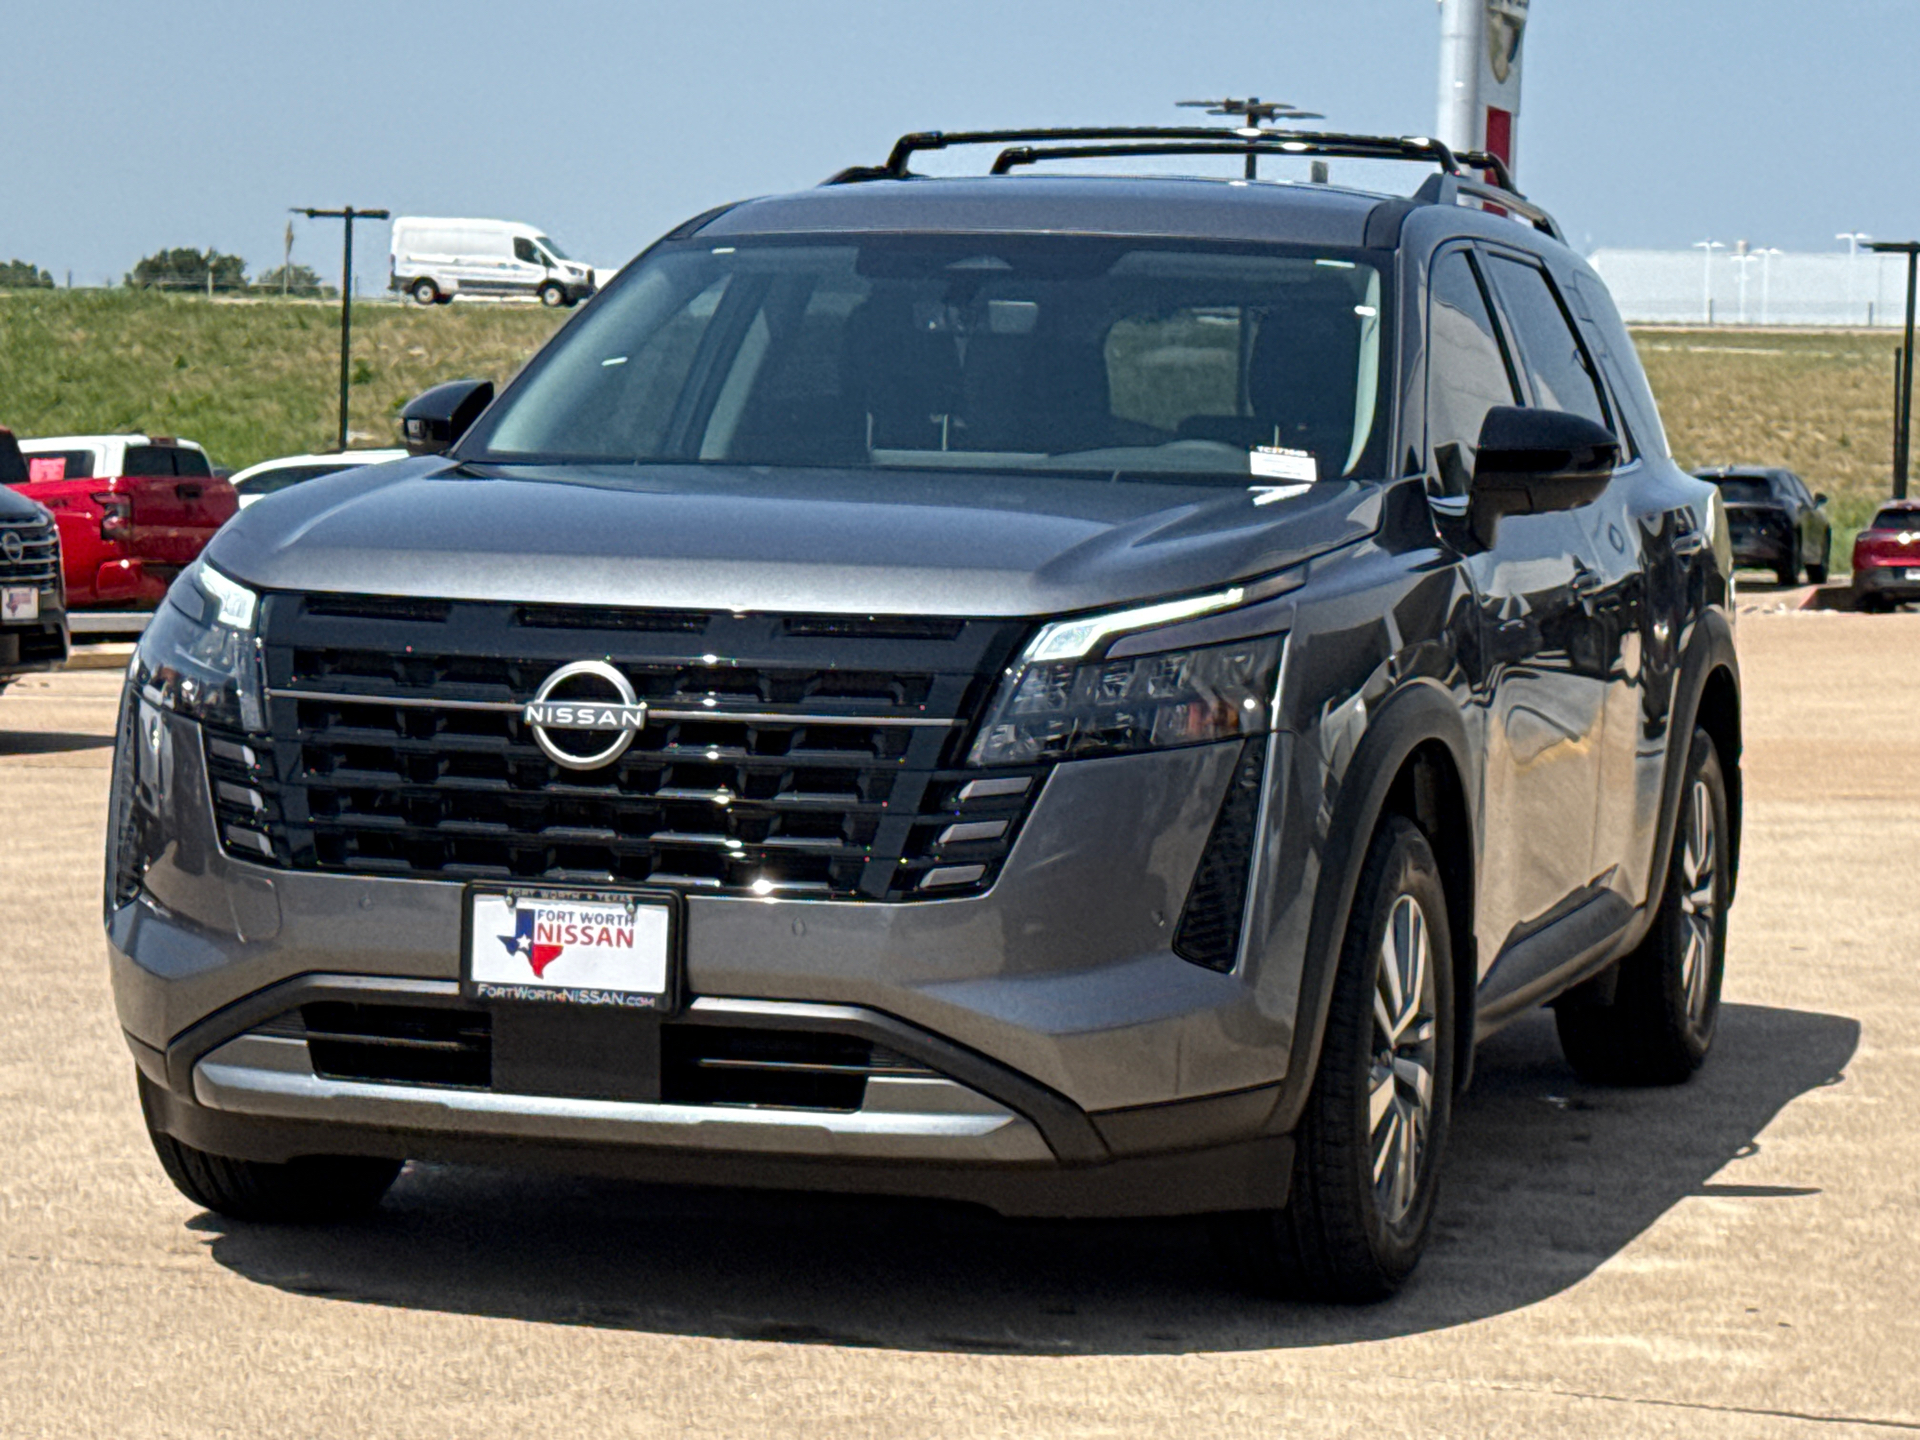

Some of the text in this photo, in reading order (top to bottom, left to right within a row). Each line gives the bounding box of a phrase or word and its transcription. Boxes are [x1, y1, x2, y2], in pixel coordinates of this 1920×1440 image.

[526, 705, 642, 727] NISSAN
[537, 909, 635, 928] FORT WORTH
[536, 922, 635, 949] NISSAN
